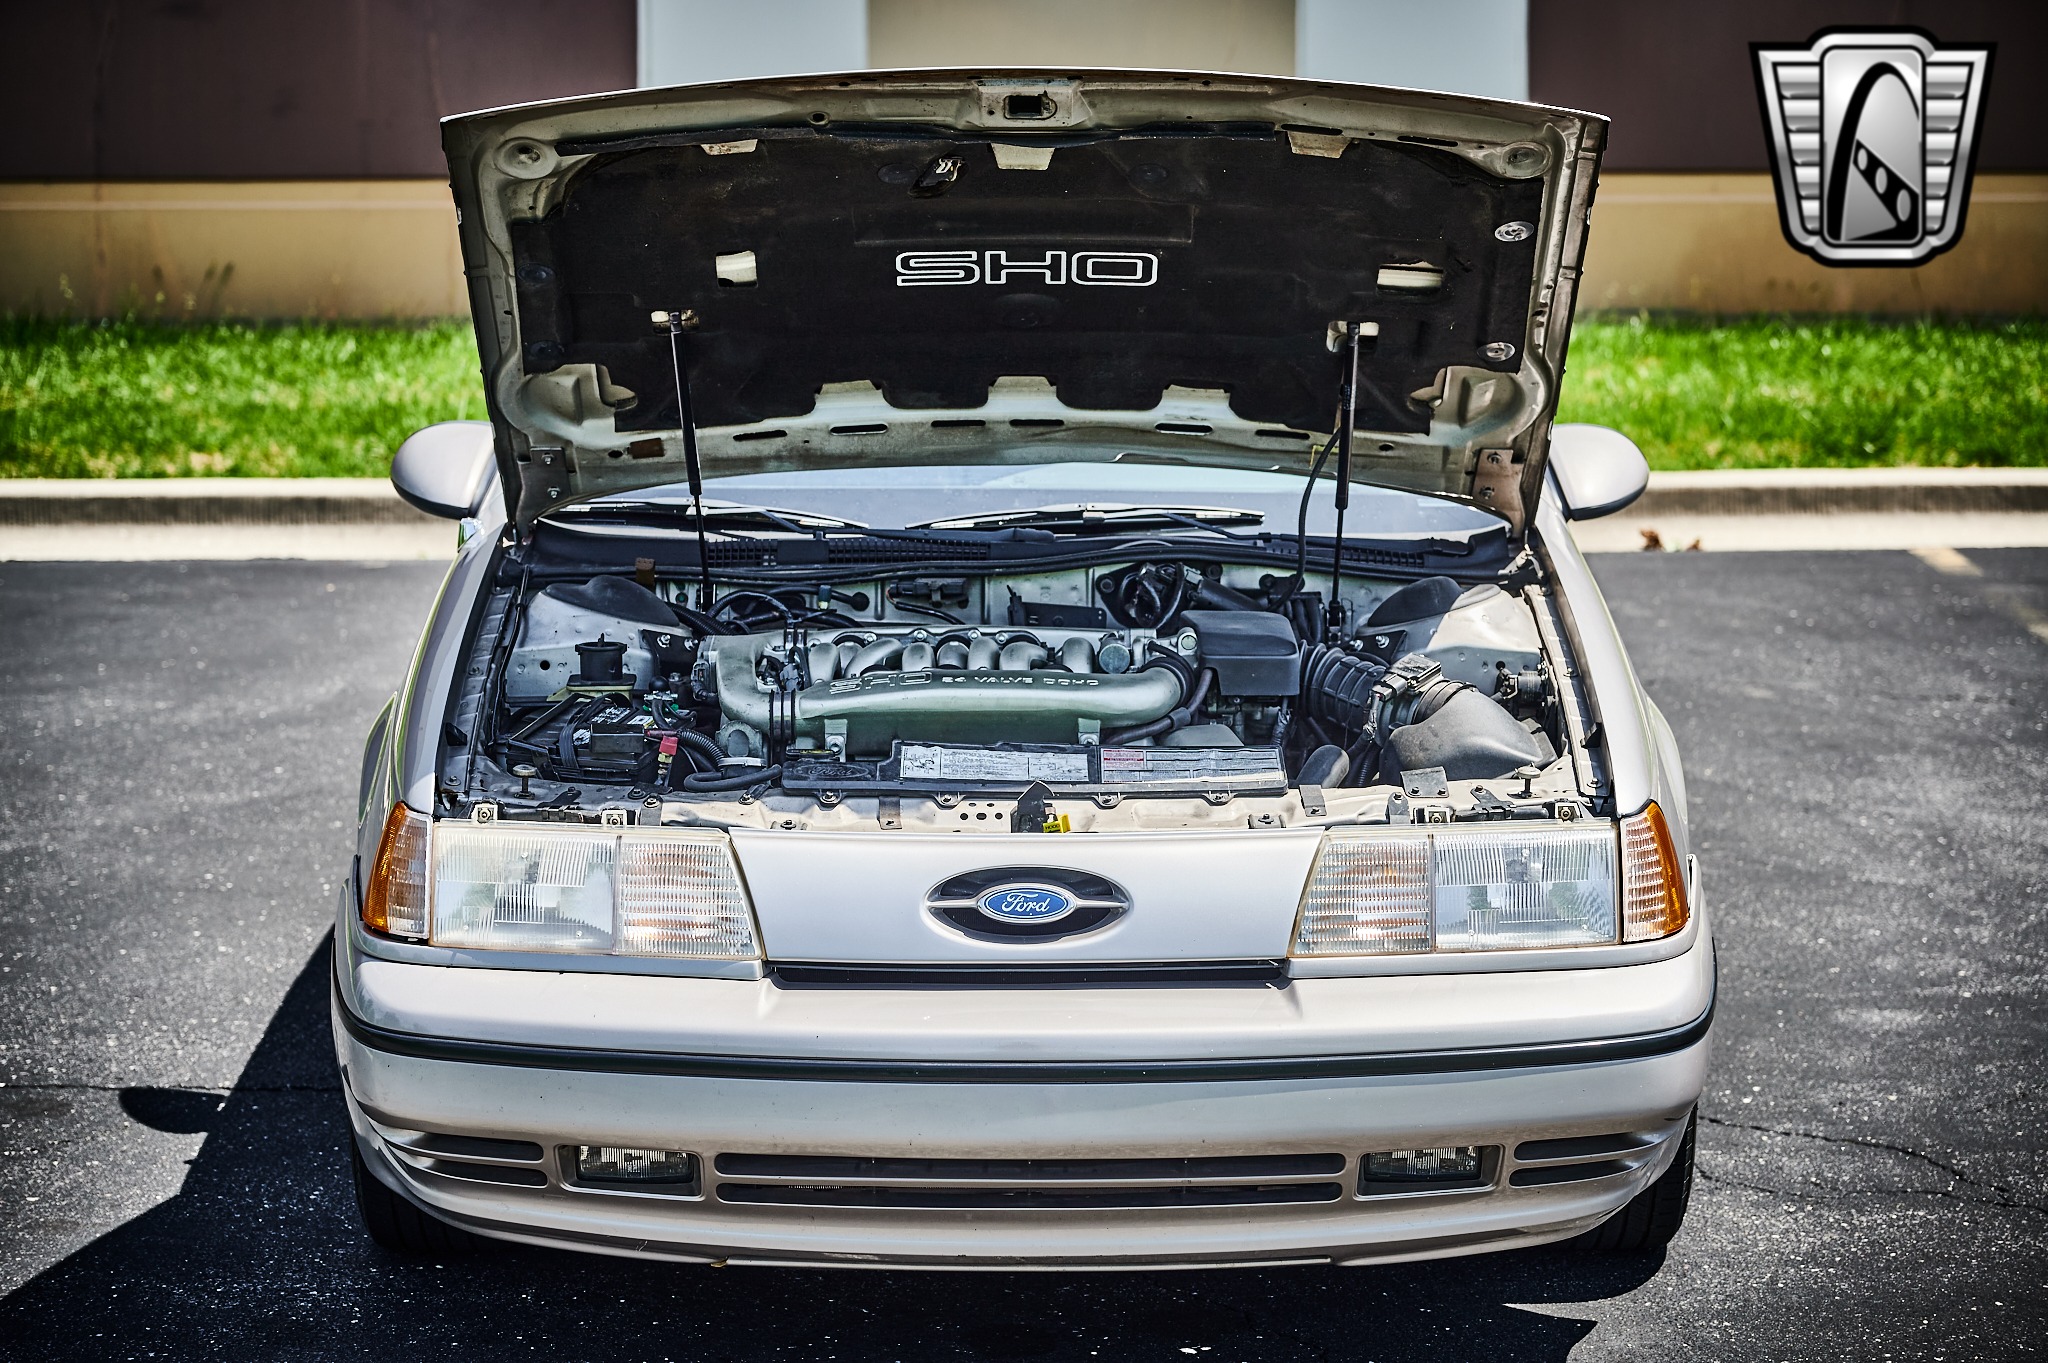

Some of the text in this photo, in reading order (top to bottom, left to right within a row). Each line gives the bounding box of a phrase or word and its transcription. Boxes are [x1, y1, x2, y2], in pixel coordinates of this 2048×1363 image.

[895, 250, 1159, 287] SHO
[829, 672, 932, 694] SHO
[974, 676, 1034, 684] VALVE
[1001, 892, 1050, 913] Ford
